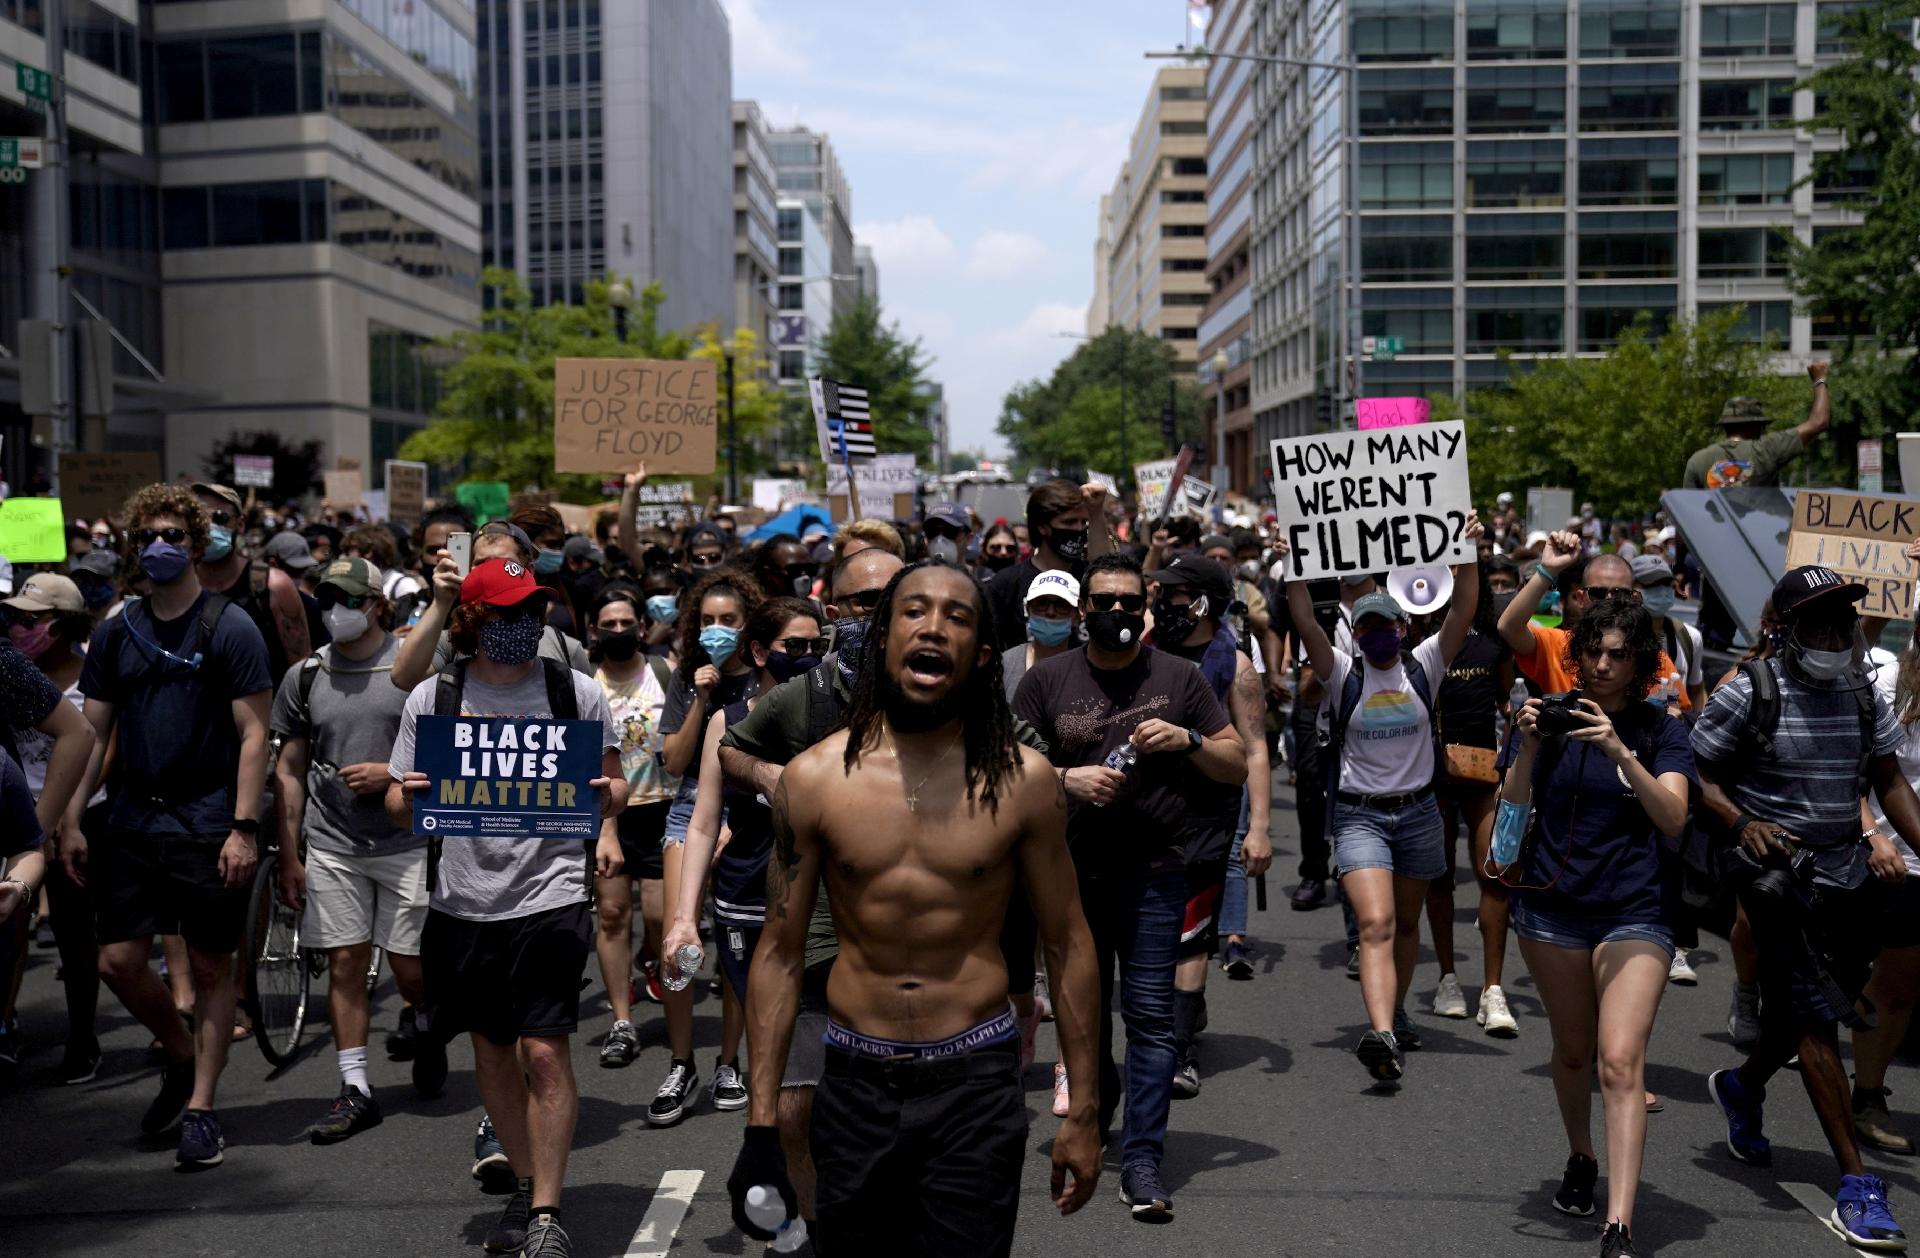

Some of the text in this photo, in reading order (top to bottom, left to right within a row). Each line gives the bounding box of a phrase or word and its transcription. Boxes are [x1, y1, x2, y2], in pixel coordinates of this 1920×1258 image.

[571, 368, 709, 401] JUSTICE
[560, 398, 717, 426] FOR GEORGE
[595, 430, 683, 455] FLOYD
[1276, 429, 1462, 480] HOW MANY
[1295, 472, 1437, 517] WEREN'T
[1806, 493, 1915, 535] BLACK
[1289, 510, 1466, 577] FILMED?
[1816, 537, 1912, 576] LIVES
[1039, 575, 1069, 588] DUKE
[454, 722, 567, 751] BLACK
[1356, 725, 1418, 741] THE COLOR RUN
[461, 752, 558, 779] LIVES
[440, 779, 576, 807] MATTER
[851, 1038, 894, 1056] LAUREN
[921, 1045, 955, 1058] POLO
[956, 1028, 994, 1050] RALPH
